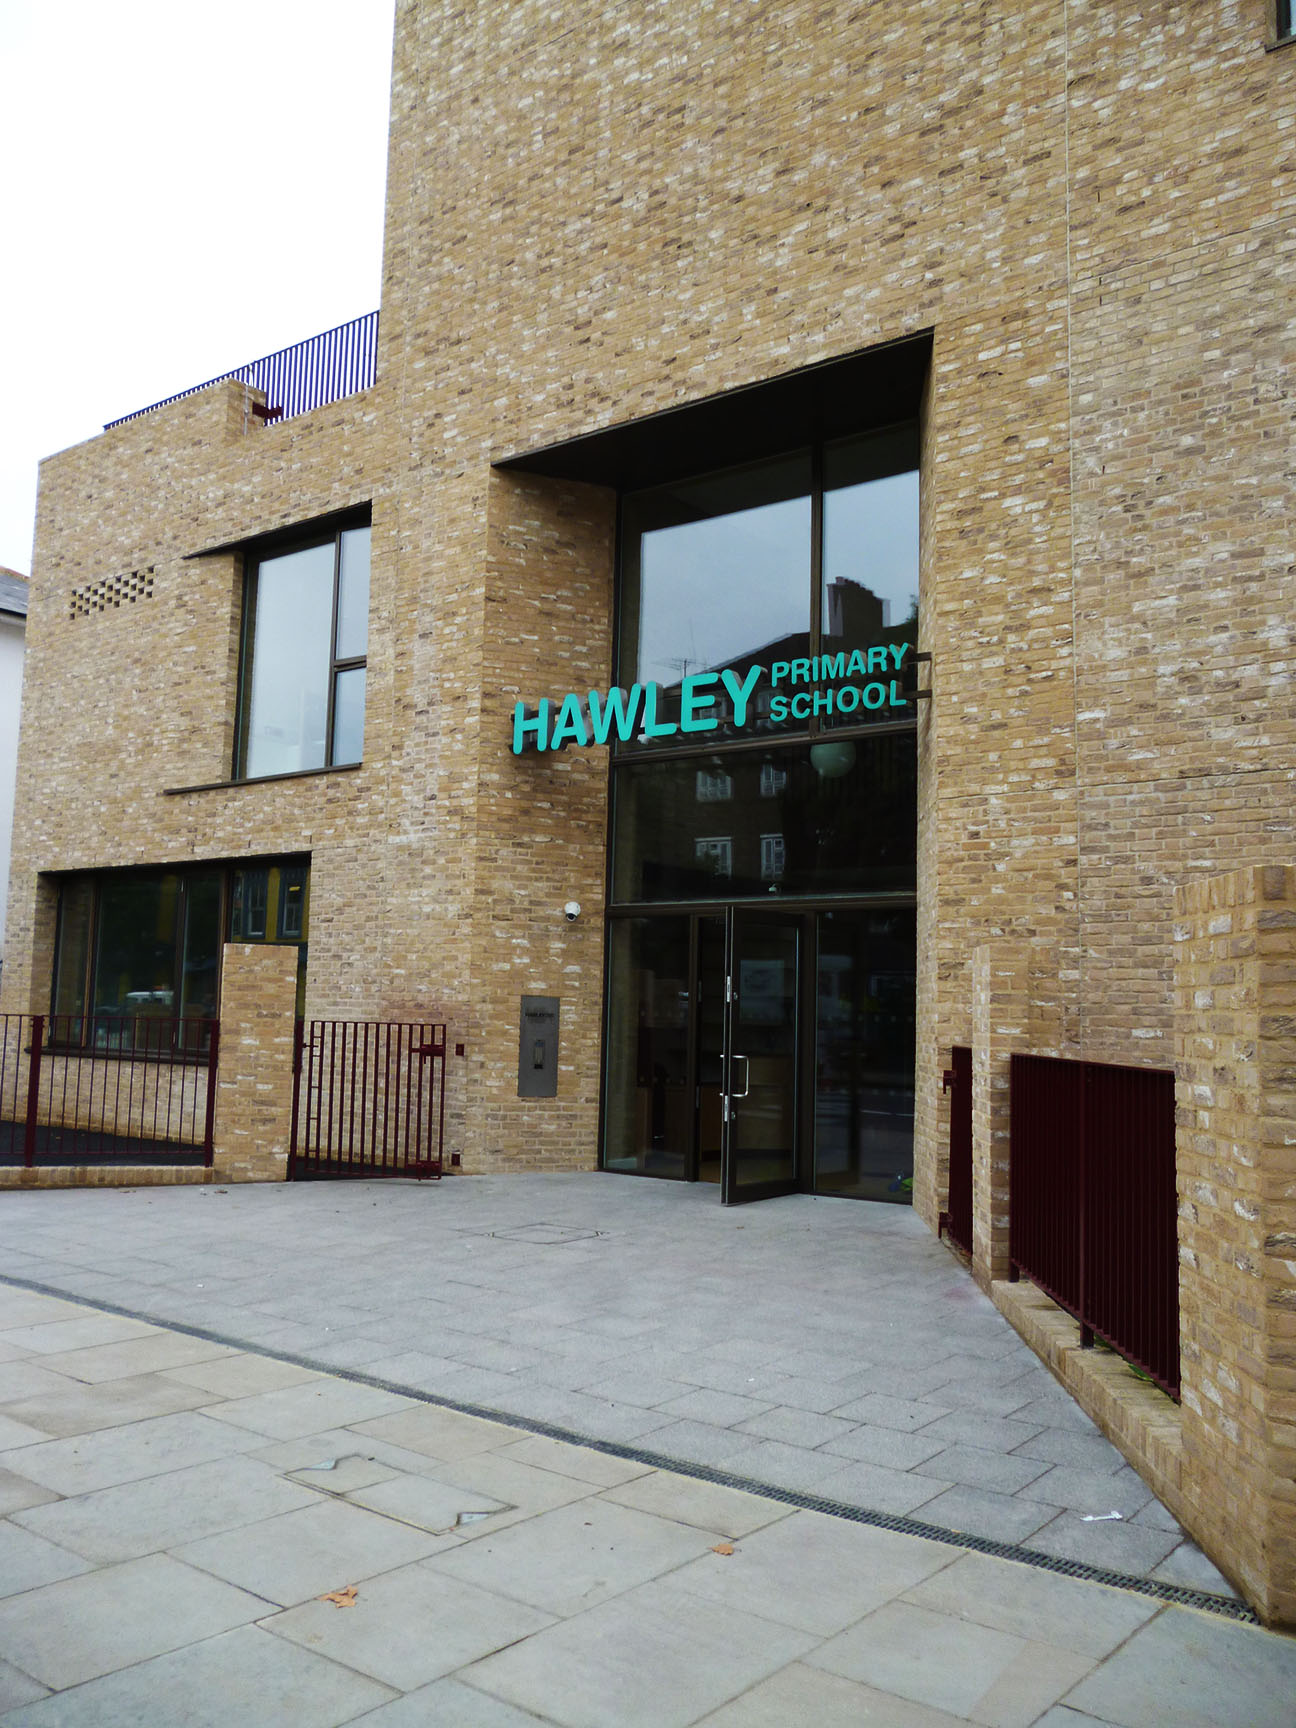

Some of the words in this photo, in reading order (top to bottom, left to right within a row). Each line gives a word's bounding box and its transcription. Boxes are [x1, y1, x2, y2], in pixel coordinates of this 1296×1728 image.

[771, 642, 910, 688] PRIMARY
[512, 665, 762, 755] HAWLEY
[769, 680, 907, 722] SCHOOL
